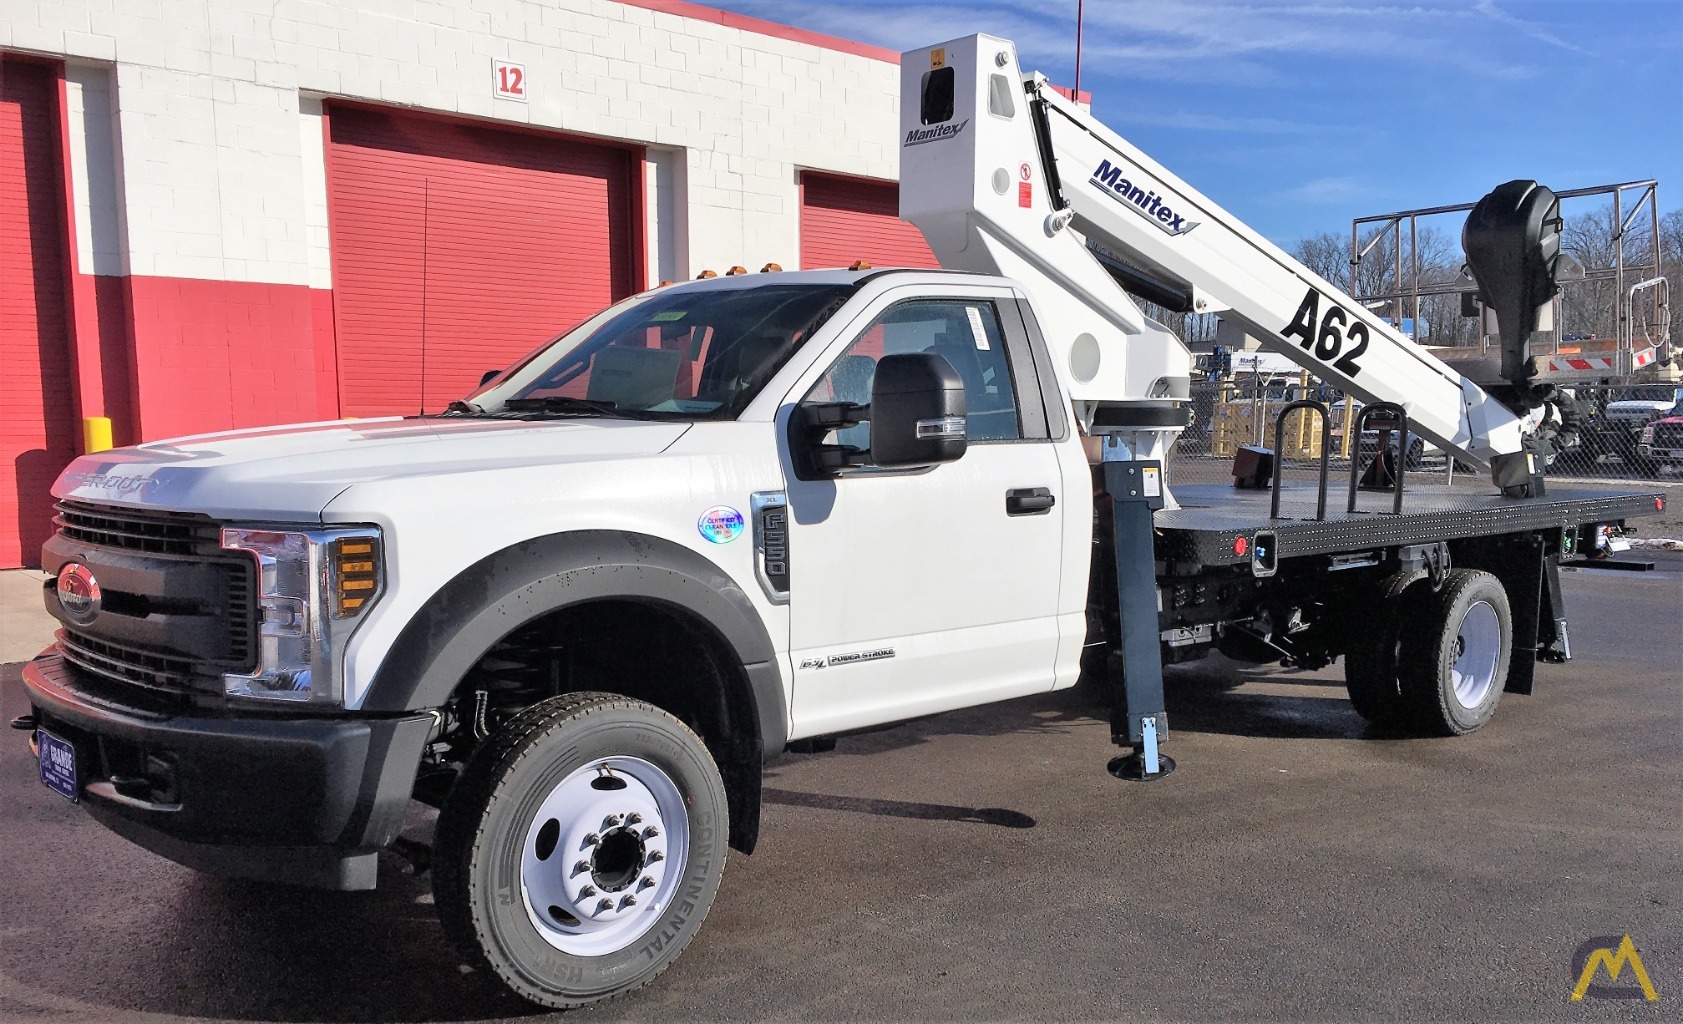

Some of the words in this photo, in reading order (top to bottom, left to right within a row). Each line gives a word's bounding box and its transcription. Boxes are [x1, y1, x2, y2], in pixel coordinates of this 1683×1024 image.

[499, 66, 522, 94] 12
[905, 123, 960, 143] Manitex
[1093, 158, 1186, 232] Manitex
[1280, 287, 1369, 378] A62
[831, 654, 861, 663] POWER
[861, 648, 894, 659] STROKE
[639, 809, 711, 961] CONTINENTAL
